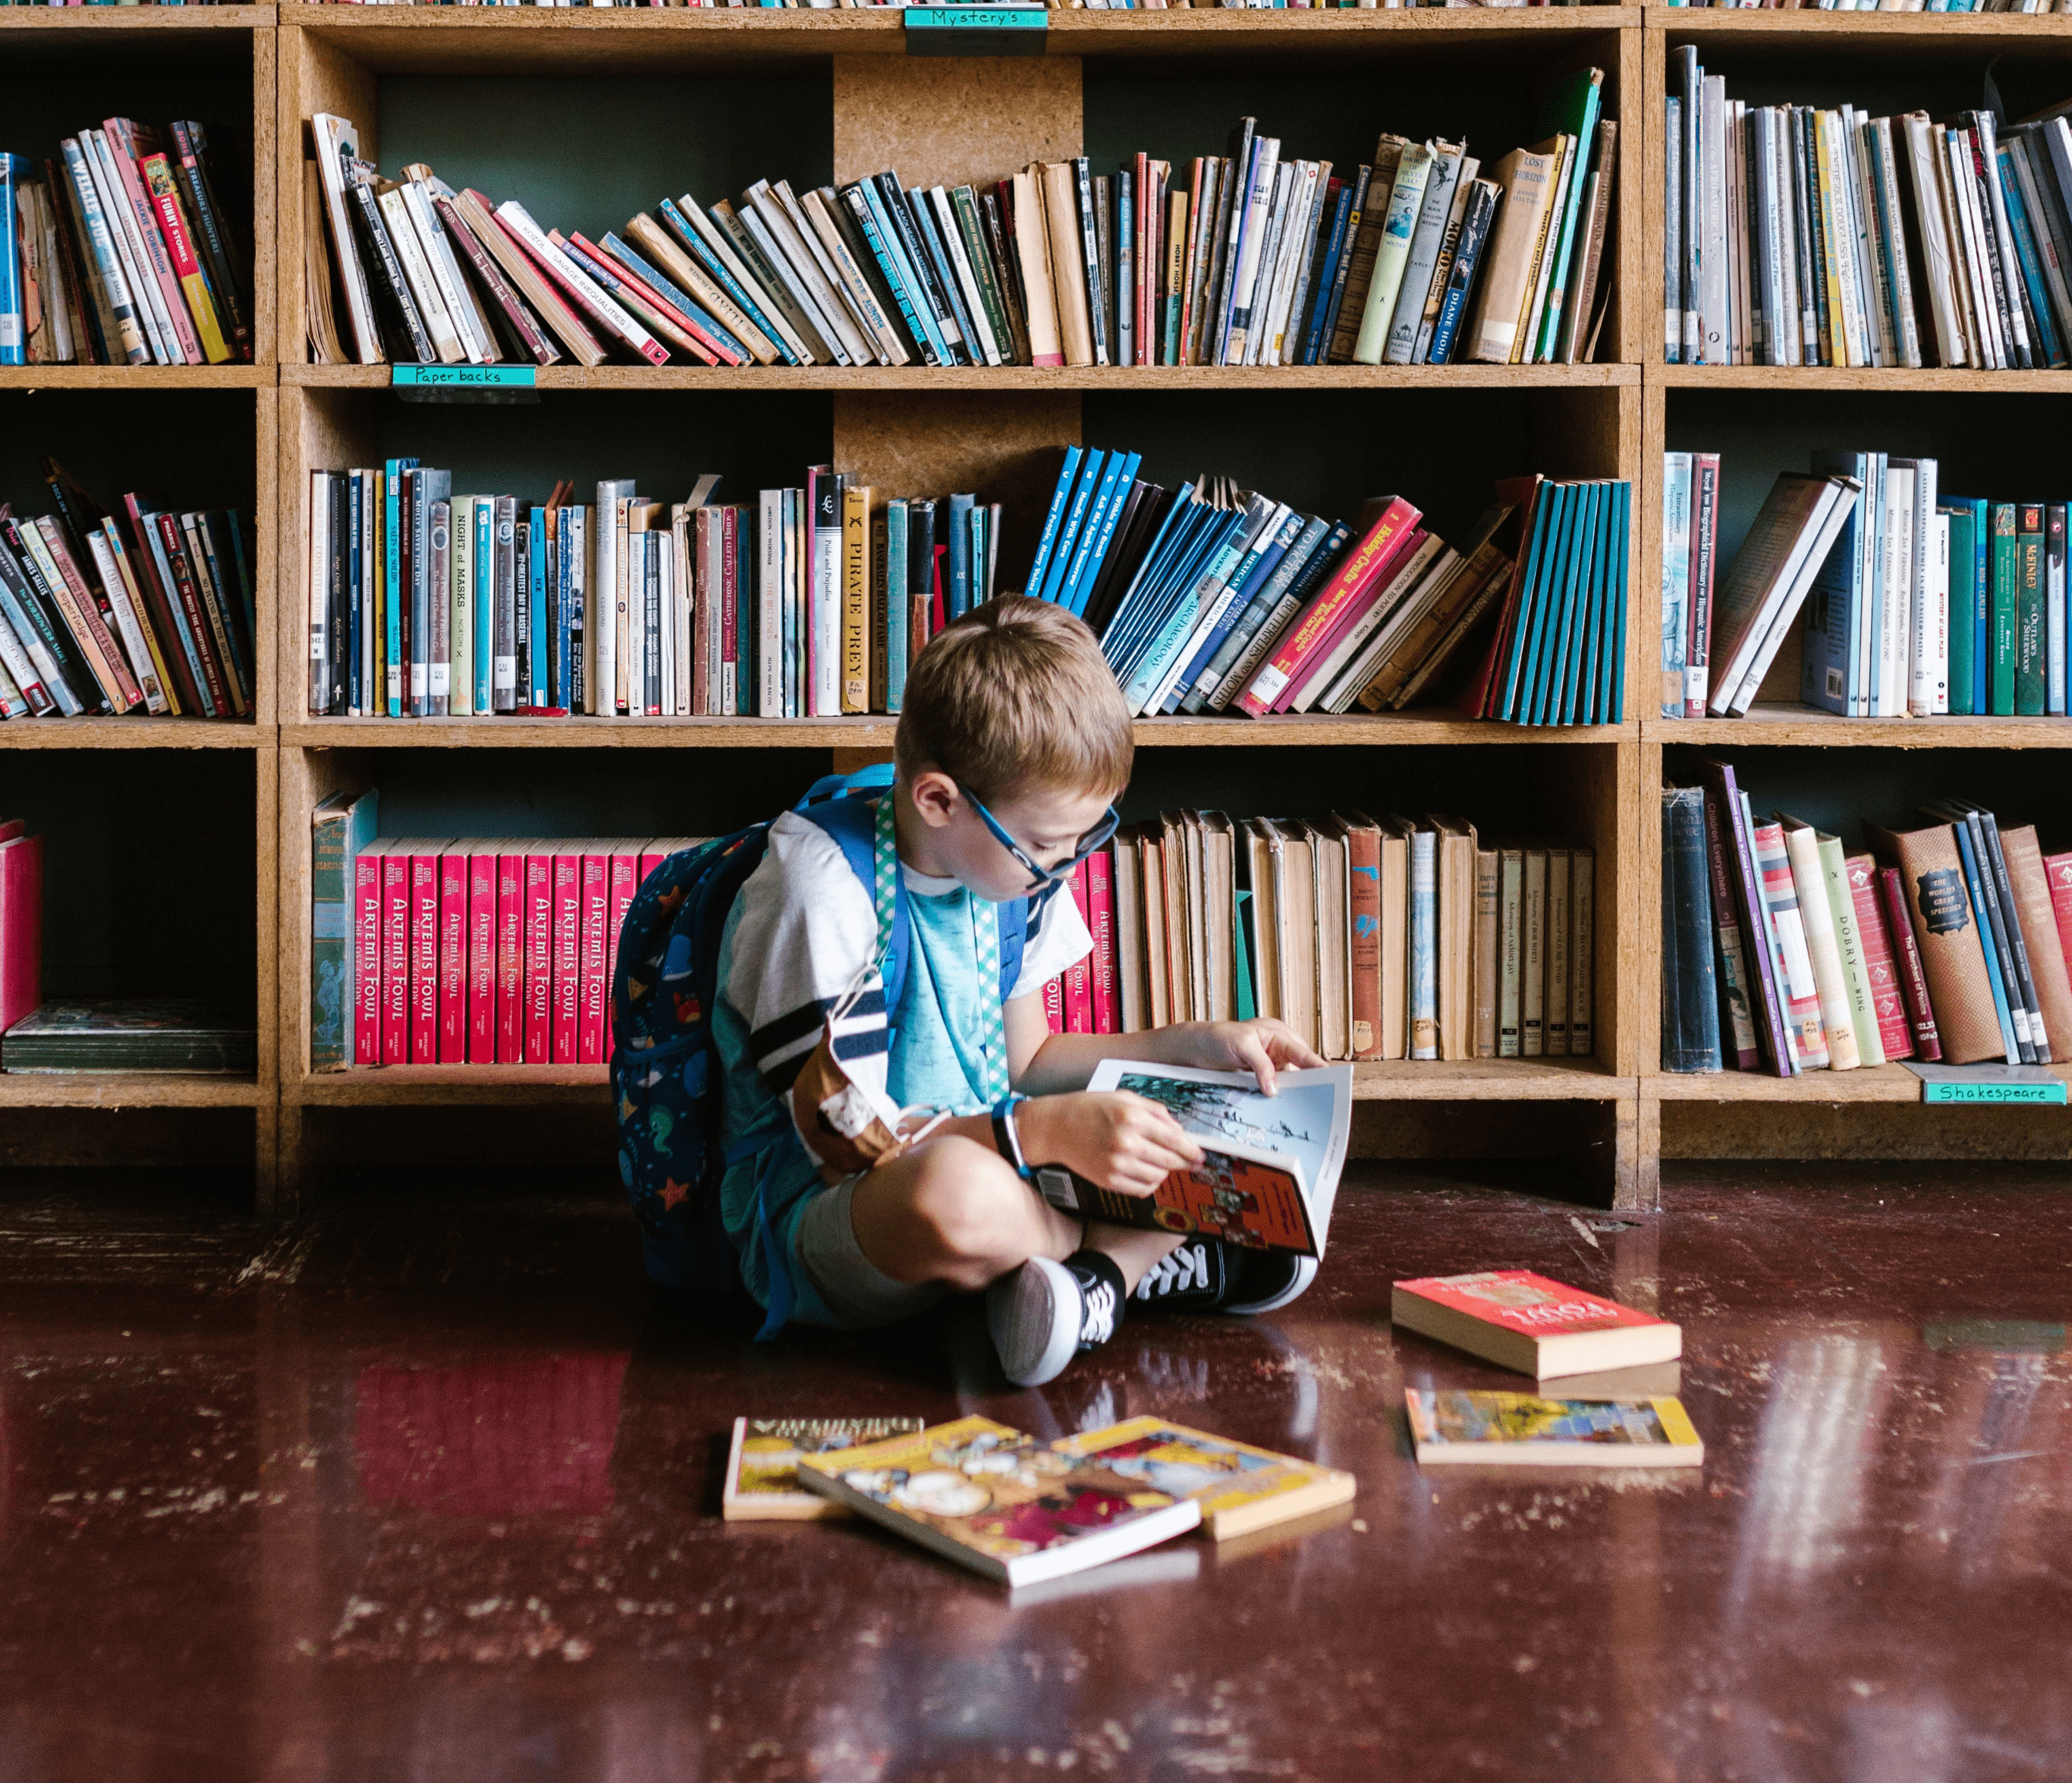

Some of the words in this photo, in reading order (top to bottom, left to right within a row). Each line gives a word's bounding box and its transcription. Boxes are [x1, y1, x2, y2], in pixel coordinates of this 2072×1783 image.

[932, 11, 1018, 26] Mystery's
[1523, 157, 1545, 167] LOST
[1553, 150, 1562, 171] Gibson
[190, 168, 207, 211] TREASURE
[203, 214, 219, 253] HUNTERS
[1540, 210, 1549, 232] Nevada
[134, 199, 149, 225] JACKIE
[146, 230, 166, 274] ROBINSON
[160, 198, 178, 228] FUNNY
[172, 229, 188, 263] STORIES
[373, 228, 384, 244] Don't
[522, 226, 546, 251] KOZOL
[379, 243, 391, 258] Look
[973, 245, 986, 267] HIDDEN
[1342, 255, 1350, 267] but
[385, 258, 398, 278] Behind
[979, 266, 989, 285] DOOR
[1530, 263, 1539, 288] Symbols
[112, 280, 124, 303] SMALL
[390, 277, 401, 288] You
[552, 255, 576, 282] SAVAGE
[579, 281, 626, 325] INEQUALITIES
[400, 294, 411, 310] LOIS
[424, 290, 437, 314] DICKENS
[811, 276, 824, 293] LLOYD
[821, 292, 841, 322] ALEXANDER
[1445, 292, 1460, 327] DIANE
[404, 308, 419, 333] DUNCAN
[1437, 331, 1449, 355] HOH
[1050, 491, 1063, 514] Many
[1073, 492, 1087, 518] Handle
[1097, 495, 1107, 510] Ask
[1108, 495, 1123, 520] Within
[1668, 483, 1676, 511] Hispanic
[1042, 514, 1056, 542] People,
[1067, 520, 1079, 539] With
[1092, 511, 1101, 524] Me
[1102, 521, 1114, 533] My
[1699, 506, 1709, 550] Biographical
[164, 520, 177, 549] PHILBRICK
[456, 515, 466, 550] NIGHT
[1082, 525, 1097, 548] Again
[1305, 530, 1317, 543] TO
[457, 555, 464, 563] of
[1034, 544, 1048, 566] Many
[1060, 539, 1071, 558] Care
[1094, 536, 1108, 558] Reach
[22, 555, 37, 576] JAMES
[31, 574, 47, 596] SALLIS
[1068, 549, 1089, 586] Tomorrow
[1202, 547, 1231, 592] ADVENTURES
[1231, 553, 1258, 588] MEXICAN
[1272, 541, 1312, 587] VICTORY
[1343, 555, 1369, 583] Crafts
[1394, 552, 1427, 592] INTRODUCTION
[1698, 552, 1708, 586] Dictionary
[457, 569, 465, 607] MASKS
[517, 563, 526, 593] GREATEST
[850, 542, 862, 614] PIRATE
[1028, 568, 1040, 591] Voices
[1387, 590, 1397, 600] TO
[60, 592, 89, 640] superfudge
[115, 599, 130, 618] VOIGT
[1203, 590, 1233, 631] AMERICANS
[1372, 599, 1389, 618] POETRY
[1696, 597, 1706, 627] Hispanic
[1247, 598, 1300, 659] BUTTERFLIES
[1354, 624, 1369, 639] Knapp
[850, 625, 862, 677] PREY
[1696, 629, 1705, 664] Americans
[1212, 671, 1244, 709] MOTHS
[1707, 803, 1719, 841] Children
[1839, 917, 1857, 966] DOBRY
[1907, 950, 1920, 981] Merchant
[1916, 991, 1926, 1015] Venice
[1854, 989, 1865, 1011] WING
[1940, 1084, 2045, 1101] Shakespeare
